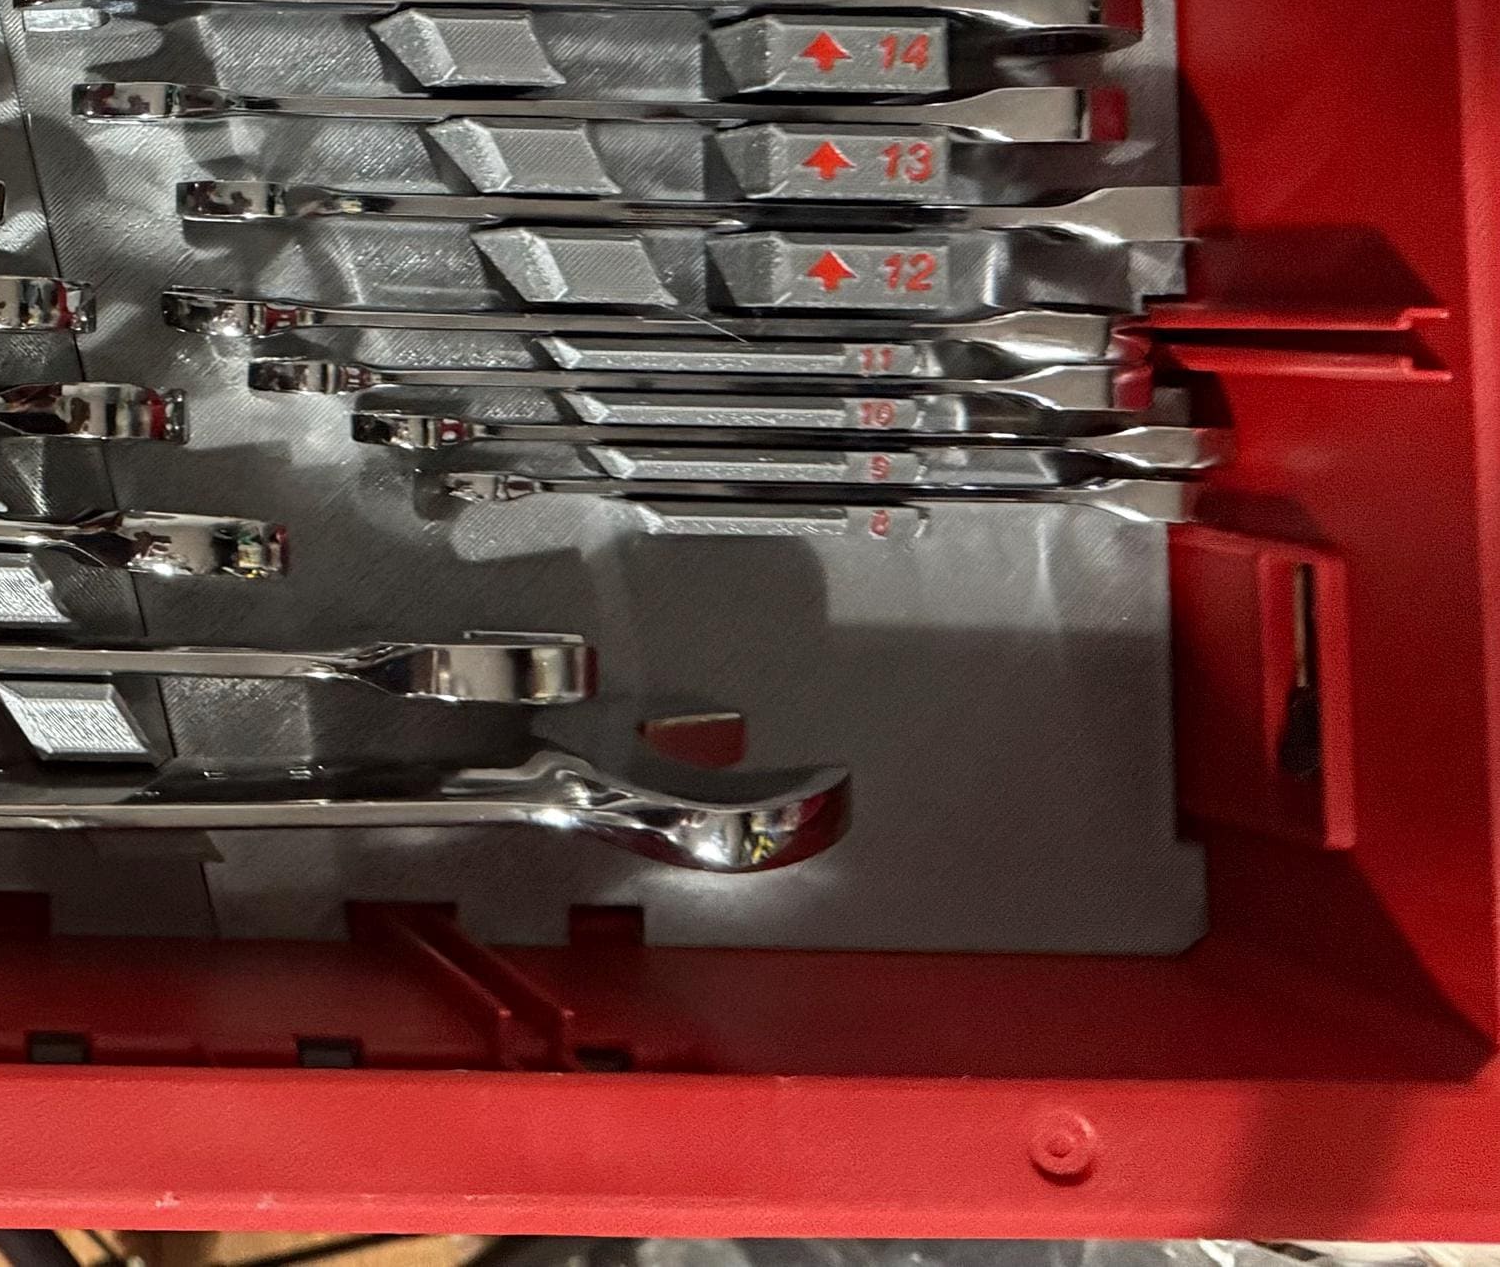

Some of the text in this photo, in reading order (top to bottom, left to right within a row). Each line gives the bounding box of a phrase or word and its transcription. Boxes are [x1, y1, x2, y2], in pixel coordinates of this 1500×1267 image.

[878, 35, 929, 68] 14
[881, 143, 933, 181] 13
[882, 254, 936, 291] 12
[861, 348, 893, 372] 11
[861, 403, 896, 426] 10
